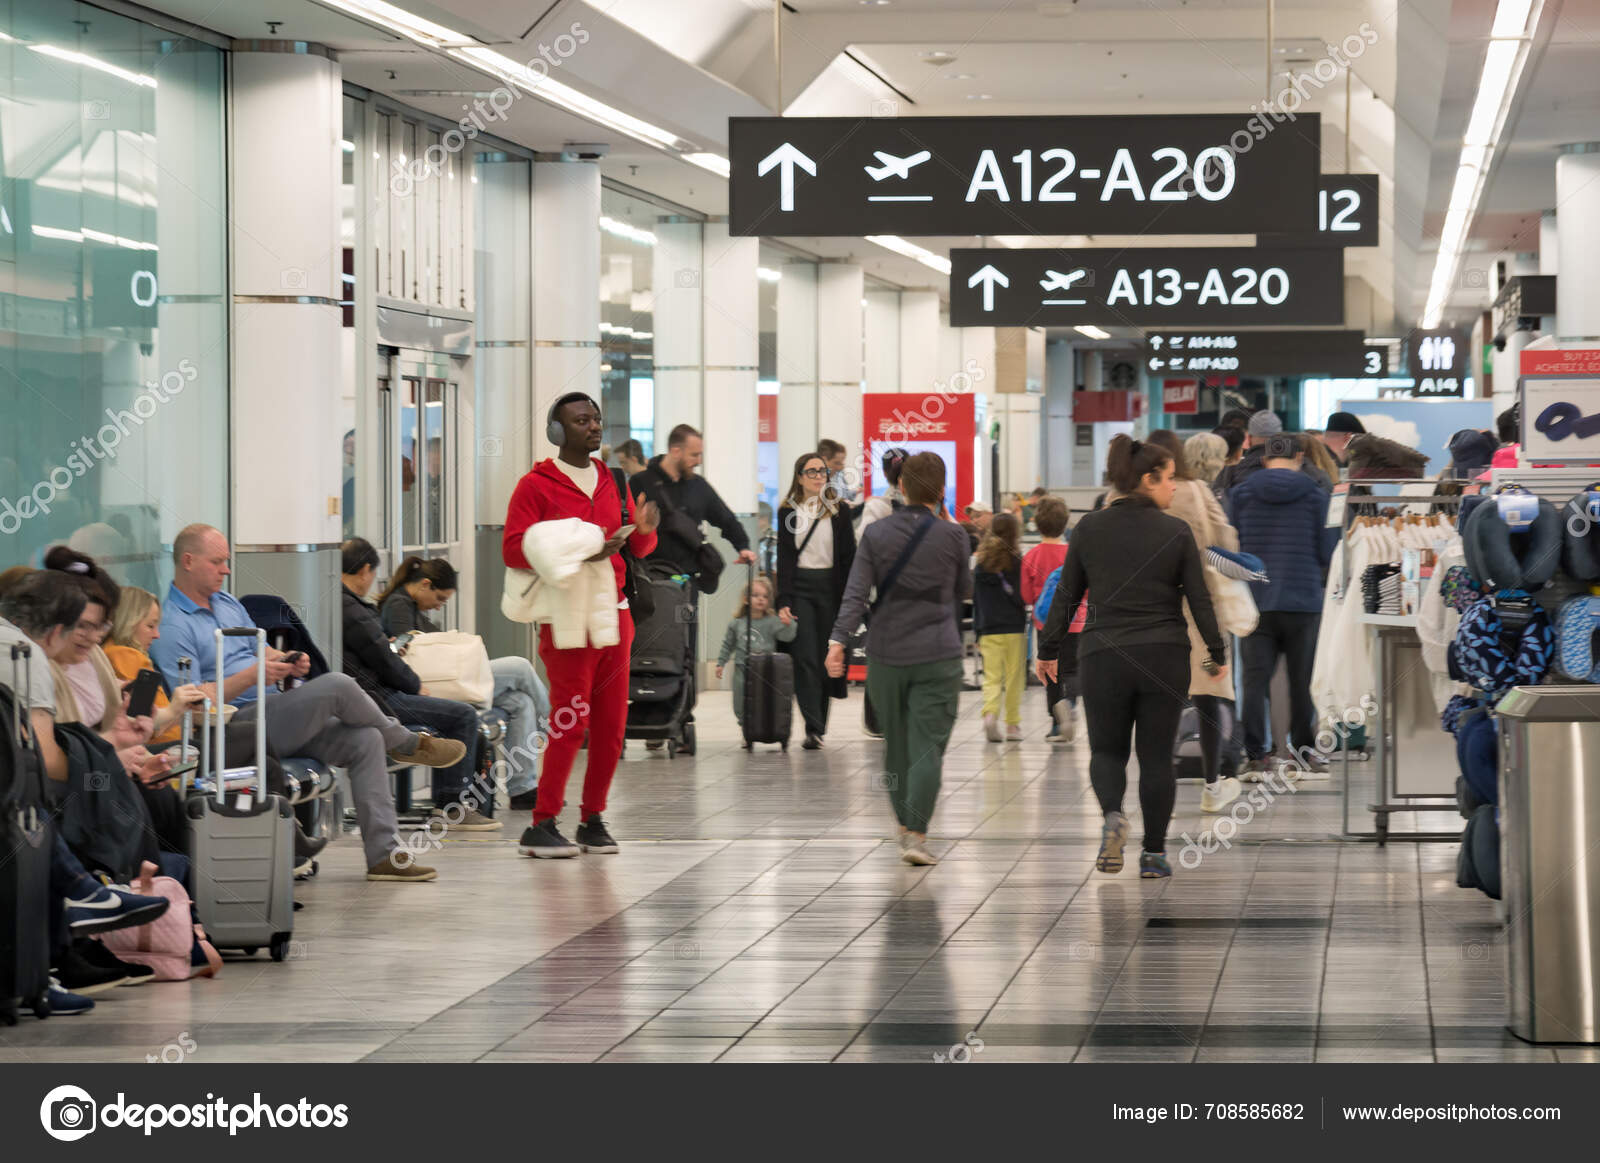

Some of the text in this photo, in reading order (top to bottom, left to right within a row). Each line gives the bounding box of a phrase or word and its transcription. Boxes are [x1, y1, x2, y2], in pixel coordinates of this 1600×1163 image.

[965, 146, 1237, 203] A12-A20
[1106, 266, 1291, 306] A13-A20
[1419, 377, 1459, 393] A14
